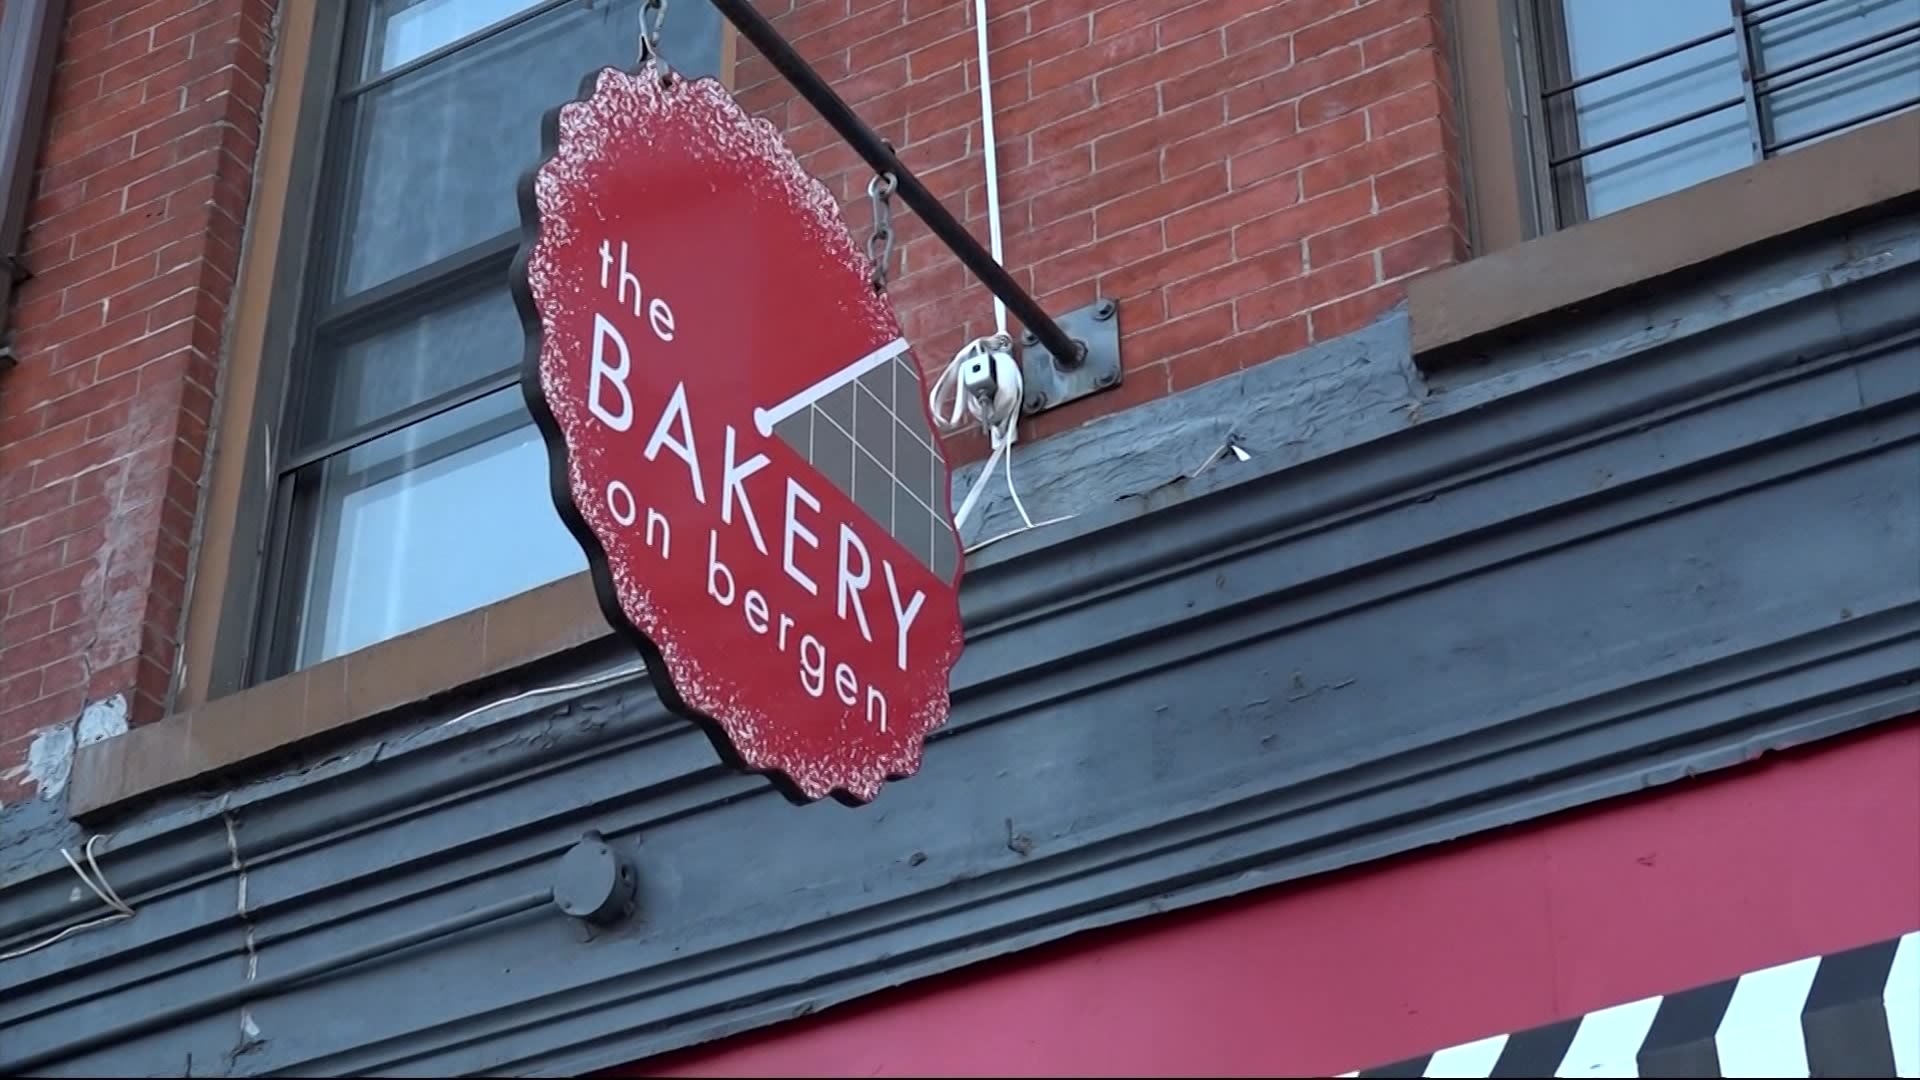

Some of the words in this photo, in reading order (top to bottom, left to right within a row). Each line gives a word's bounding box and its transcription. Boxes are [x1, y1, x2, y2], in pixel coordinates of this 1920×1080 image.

[598, 239, 675, 343] the
[588, 312, 926, 671] BAKERY
[606, 480, 671, 560] on
[708, 529, 888, 734] bergen
